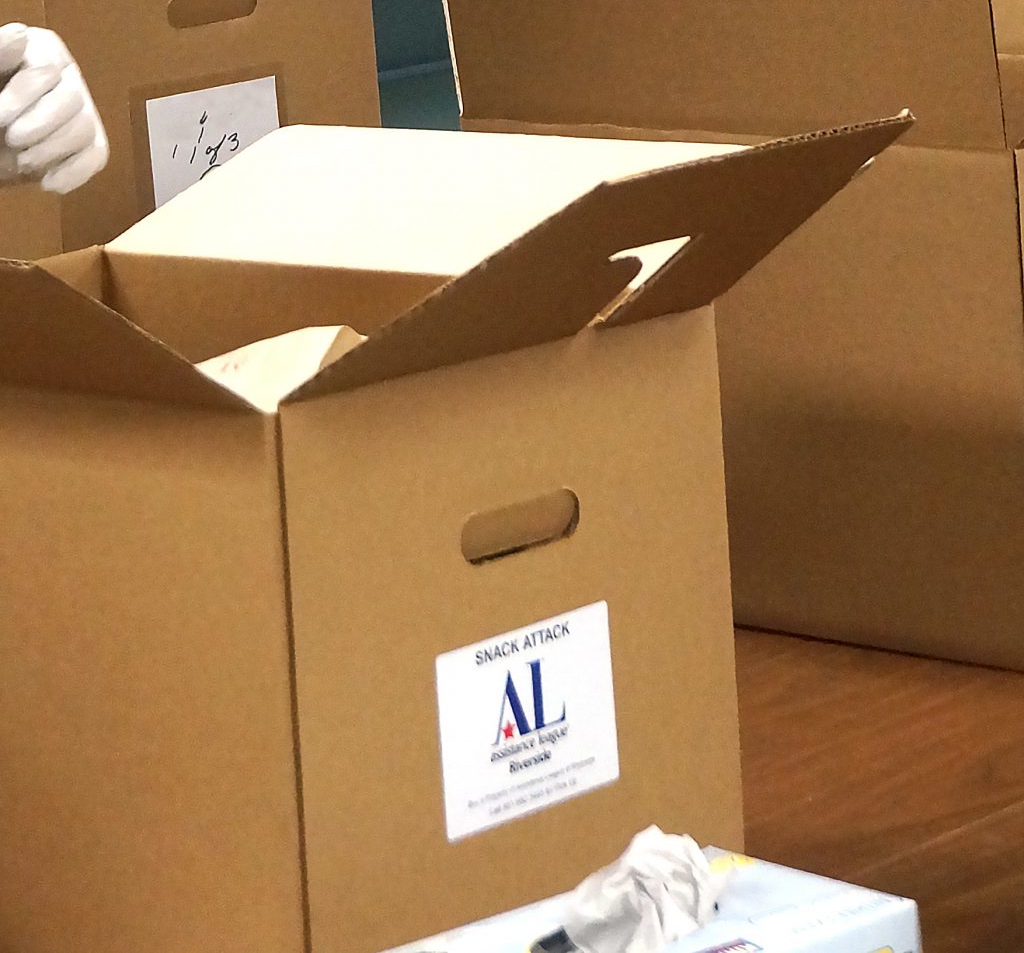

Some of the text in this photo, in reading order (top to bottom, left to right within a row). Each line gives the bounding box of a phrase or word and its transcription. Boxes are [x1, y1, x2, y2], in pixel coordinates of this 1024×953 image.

[227, 132, 240, 152] 3
[475, 621, 571, 666] SNACK ATTACK
